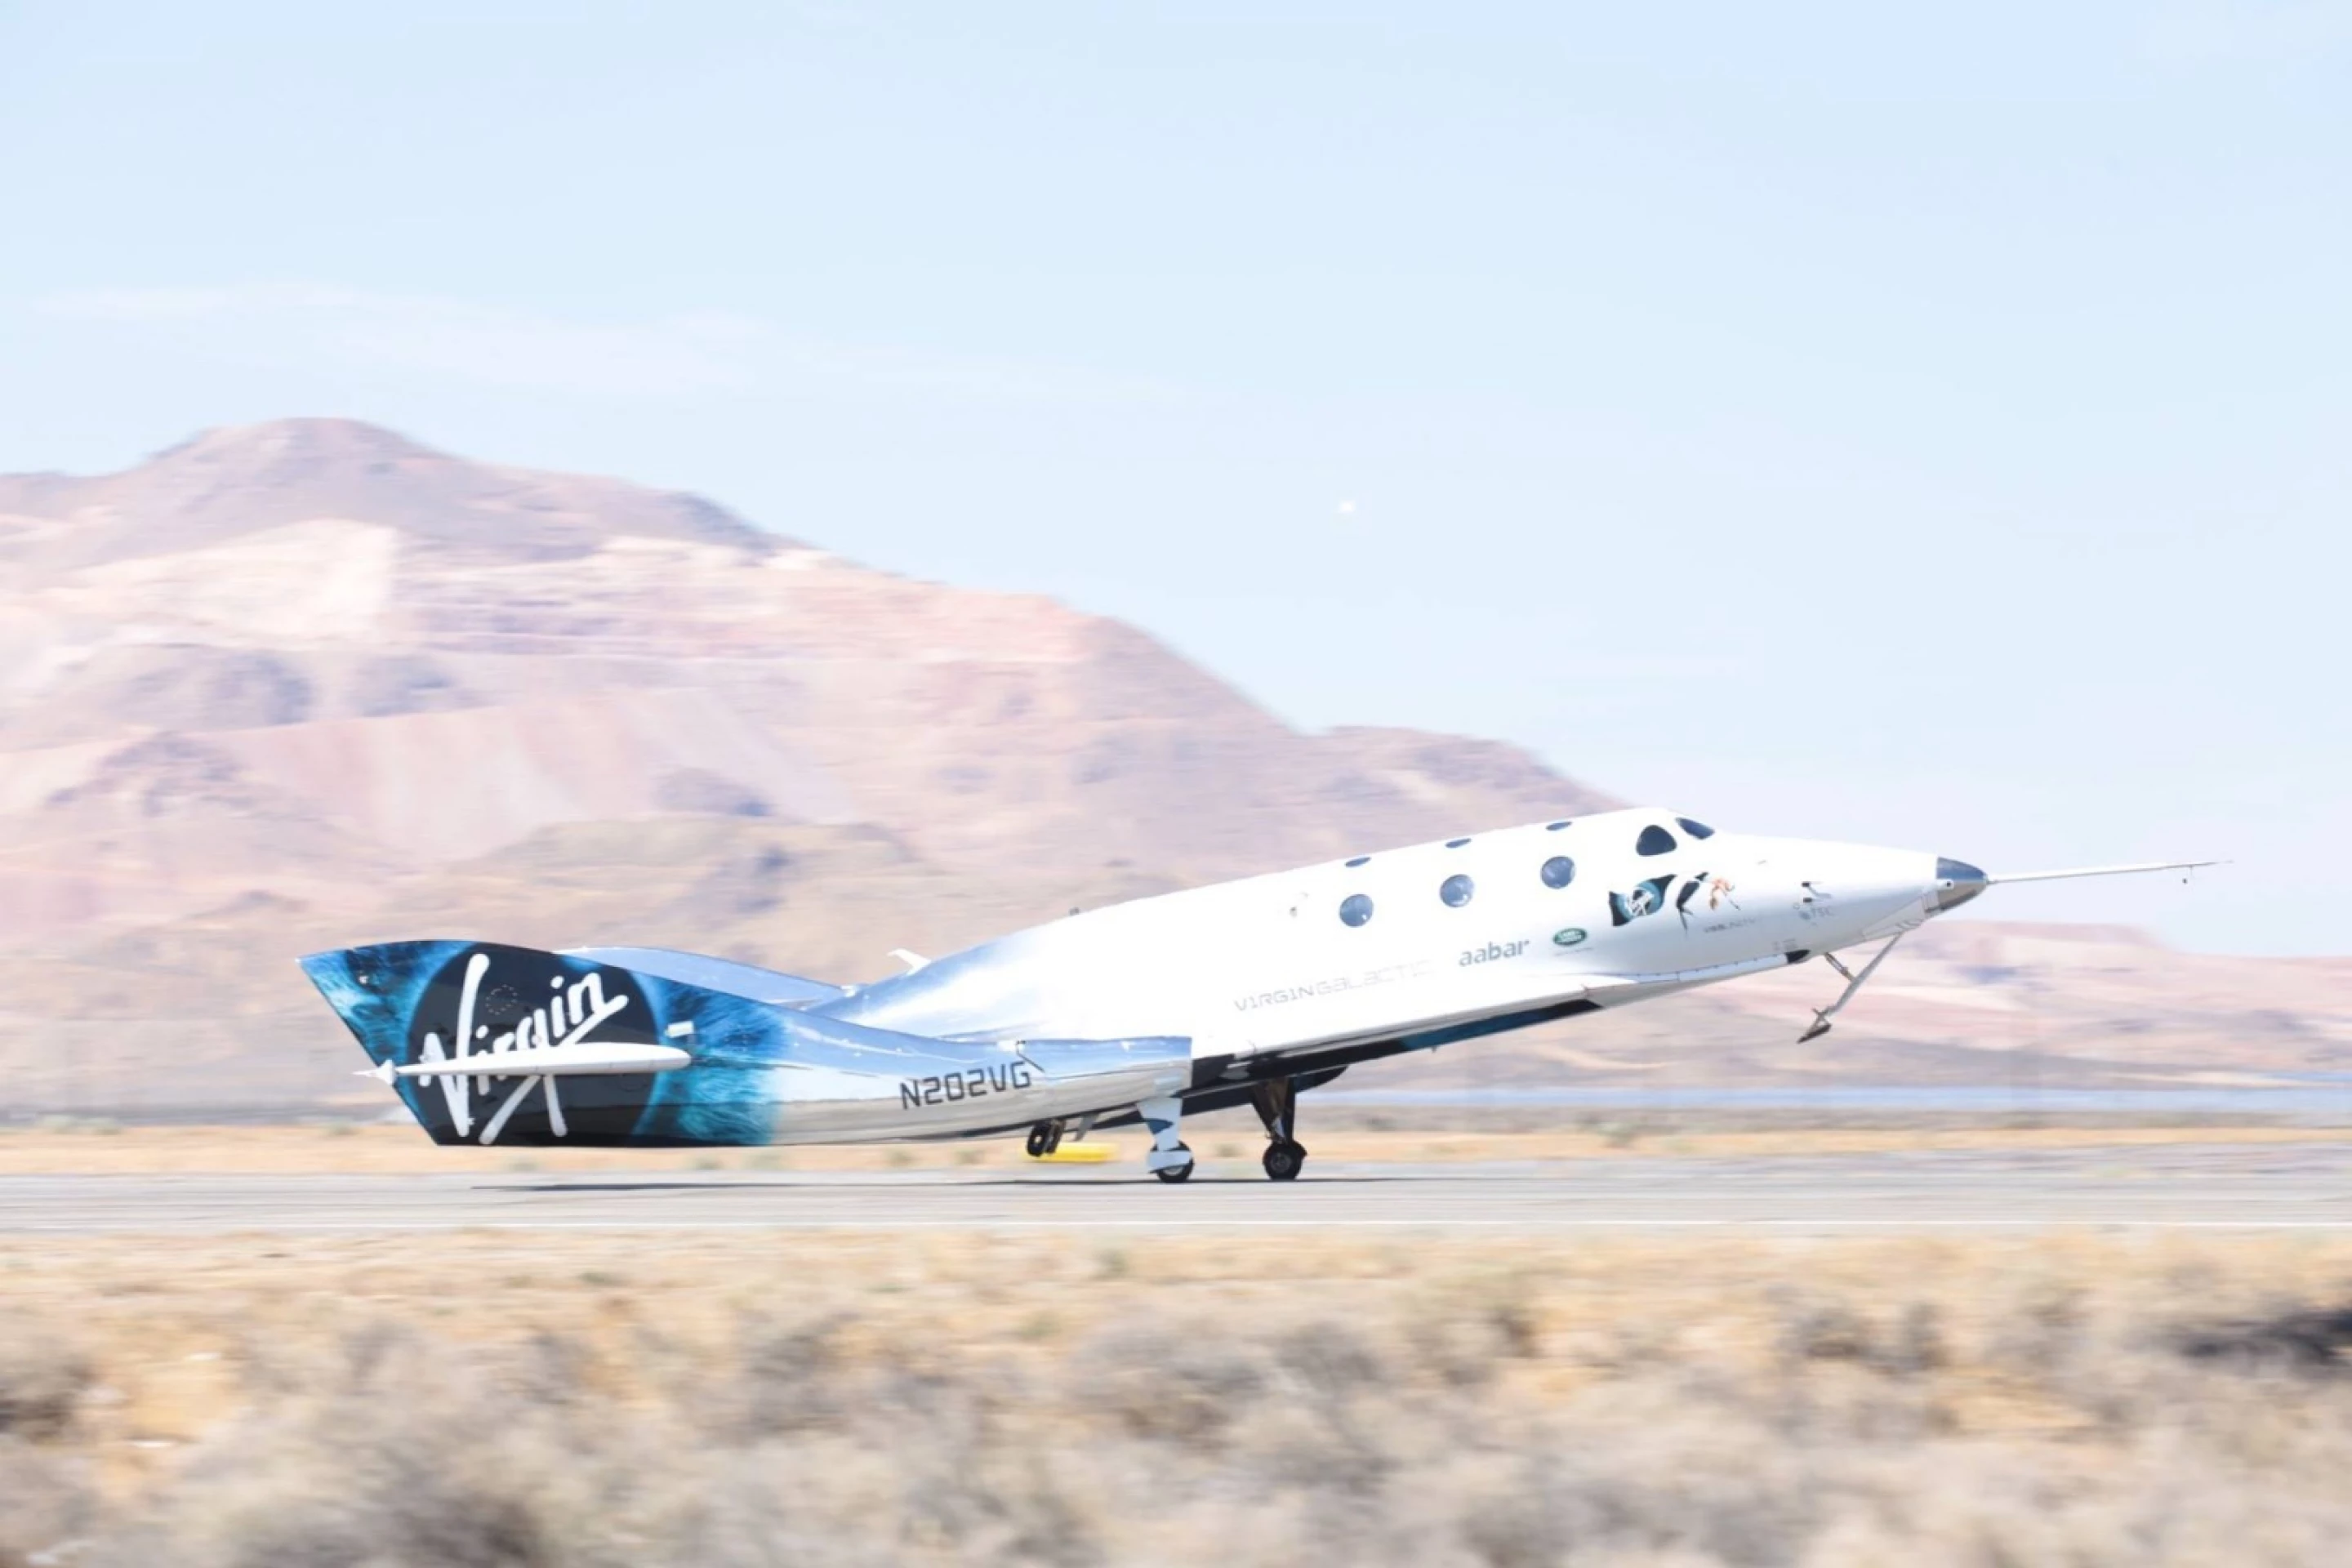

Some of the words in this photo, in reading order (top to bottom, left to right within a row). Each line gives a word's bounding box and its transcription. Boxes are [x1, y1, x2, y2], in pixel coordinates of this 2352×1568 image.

[1459, 939, 1530, 967] aabar
[419, 953, 629, 1145] Virgin
[900, 1061, 1031, 1111] N202VG
